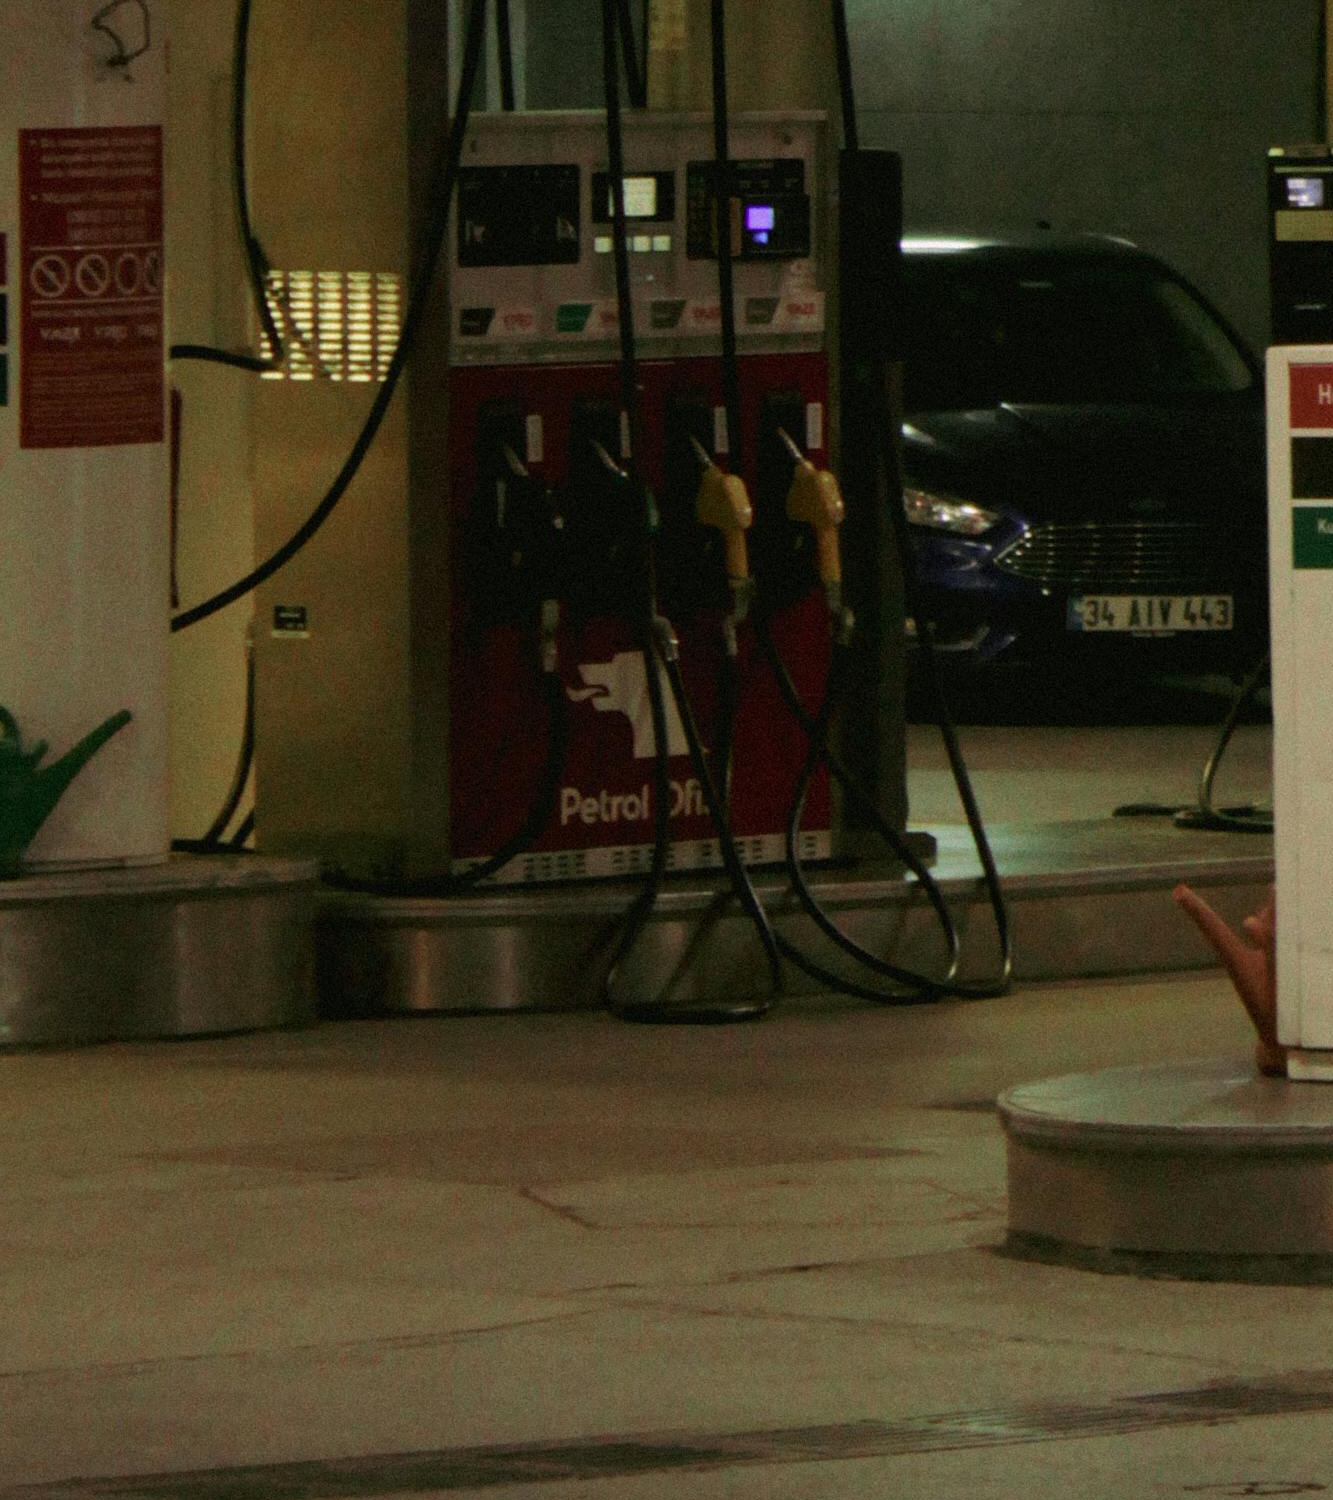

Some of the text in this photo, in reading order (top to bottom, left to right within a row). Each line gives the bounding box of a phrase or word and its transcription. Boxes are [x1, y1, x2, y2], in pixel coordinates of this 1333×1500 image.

[1085, 599, 1115, 627] 34
[1183, 599, 1229, 626] 443
[560, 783, 651, 826] Petrol
